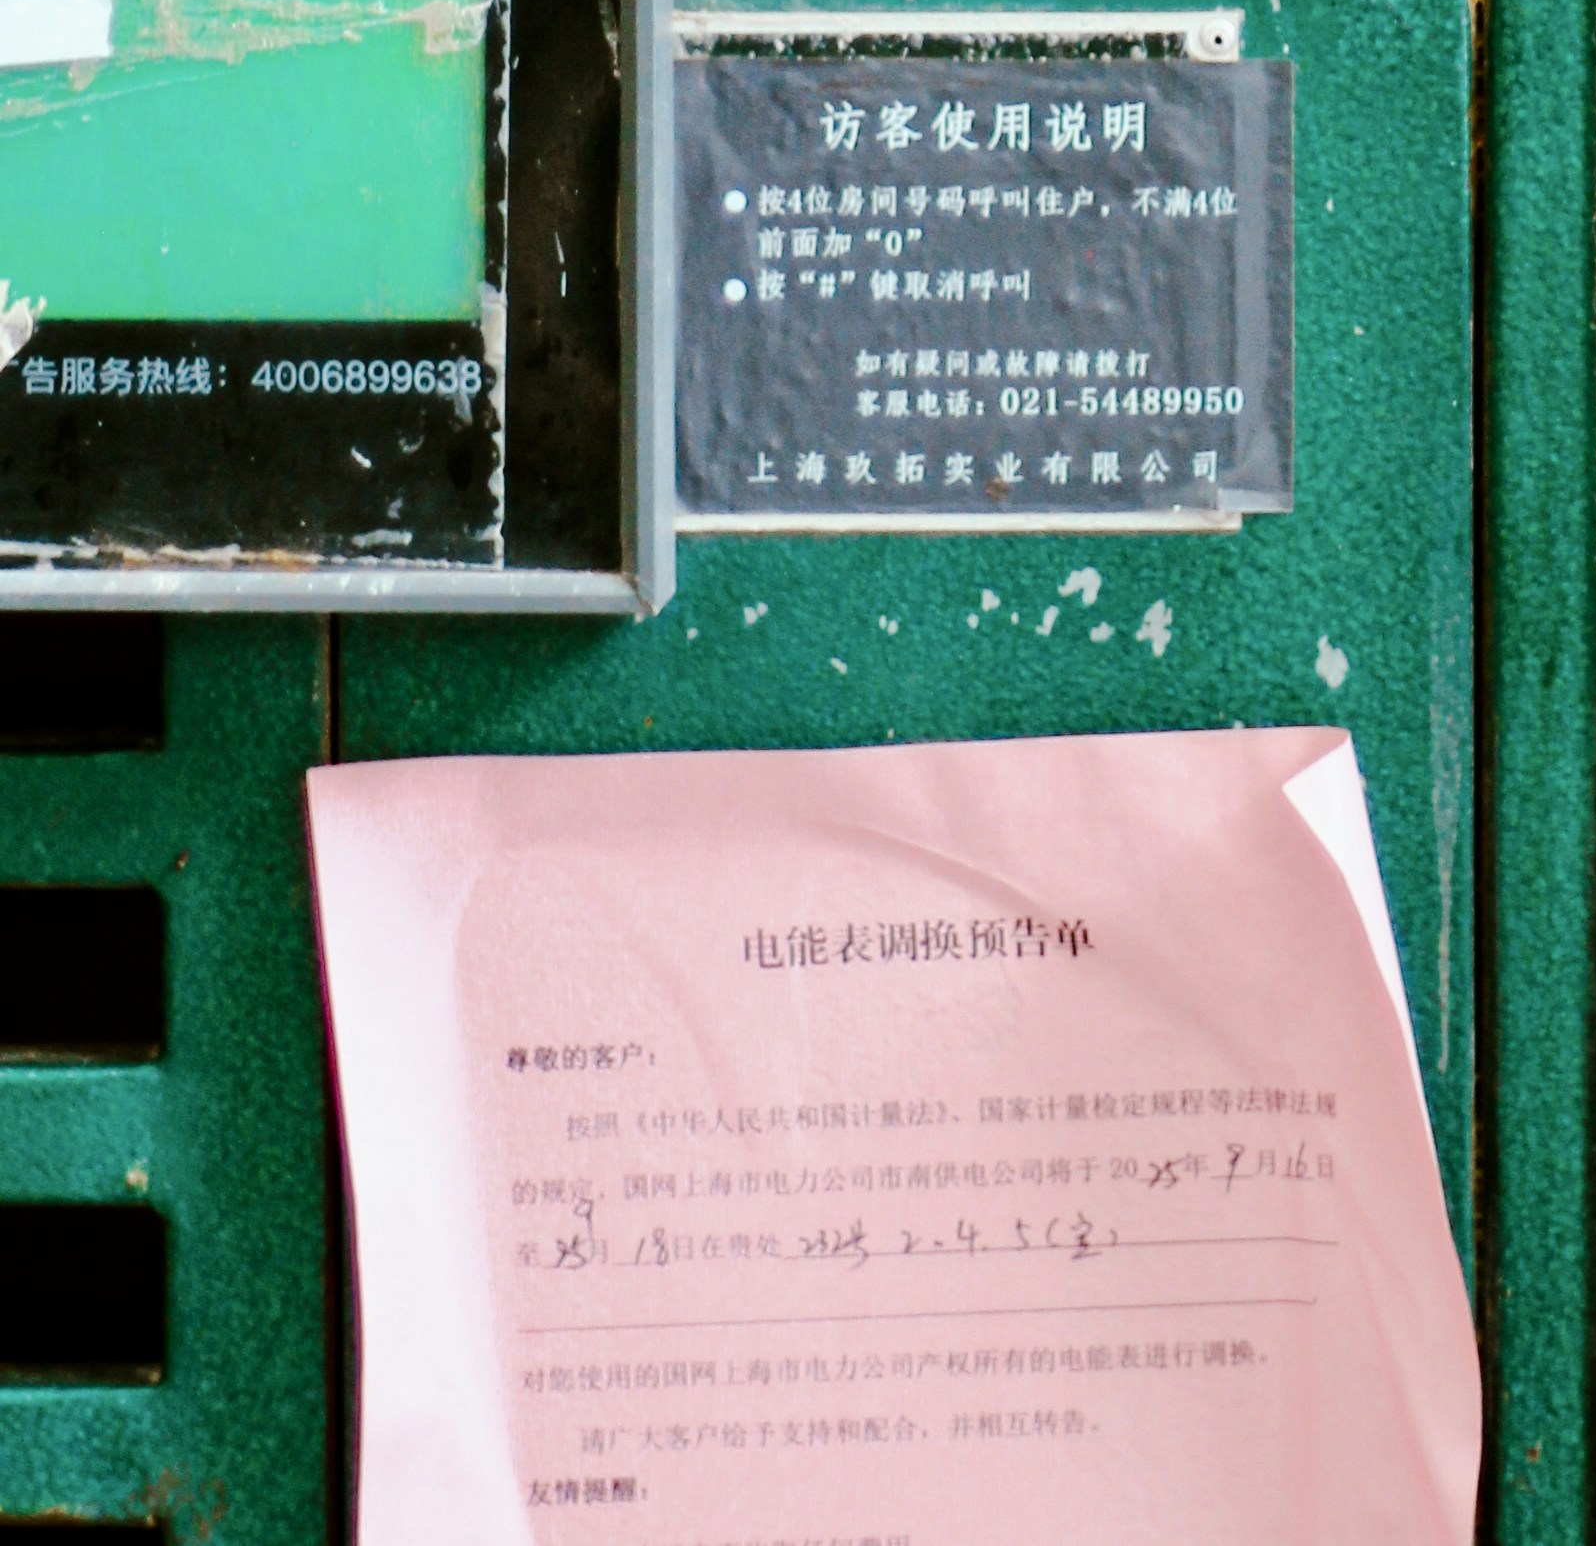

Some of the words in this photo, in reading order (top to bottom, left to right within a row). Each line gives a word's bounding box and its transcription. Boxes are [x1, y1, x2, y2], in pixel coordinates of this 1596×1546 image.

[819, 101, 1148, 153] 访客使用说明
[855, 349, 1151, 379] 如有疑问或故障请拨打
[747, 449, 1220, 486] 上海玖拓实业有限公司
[743, 916, 1095, 970] 电能表调换预告单
[506, 1041, 656, 1073] 尊敬的客户：
[528, 1476, 648, 1507] 友情提醒：
